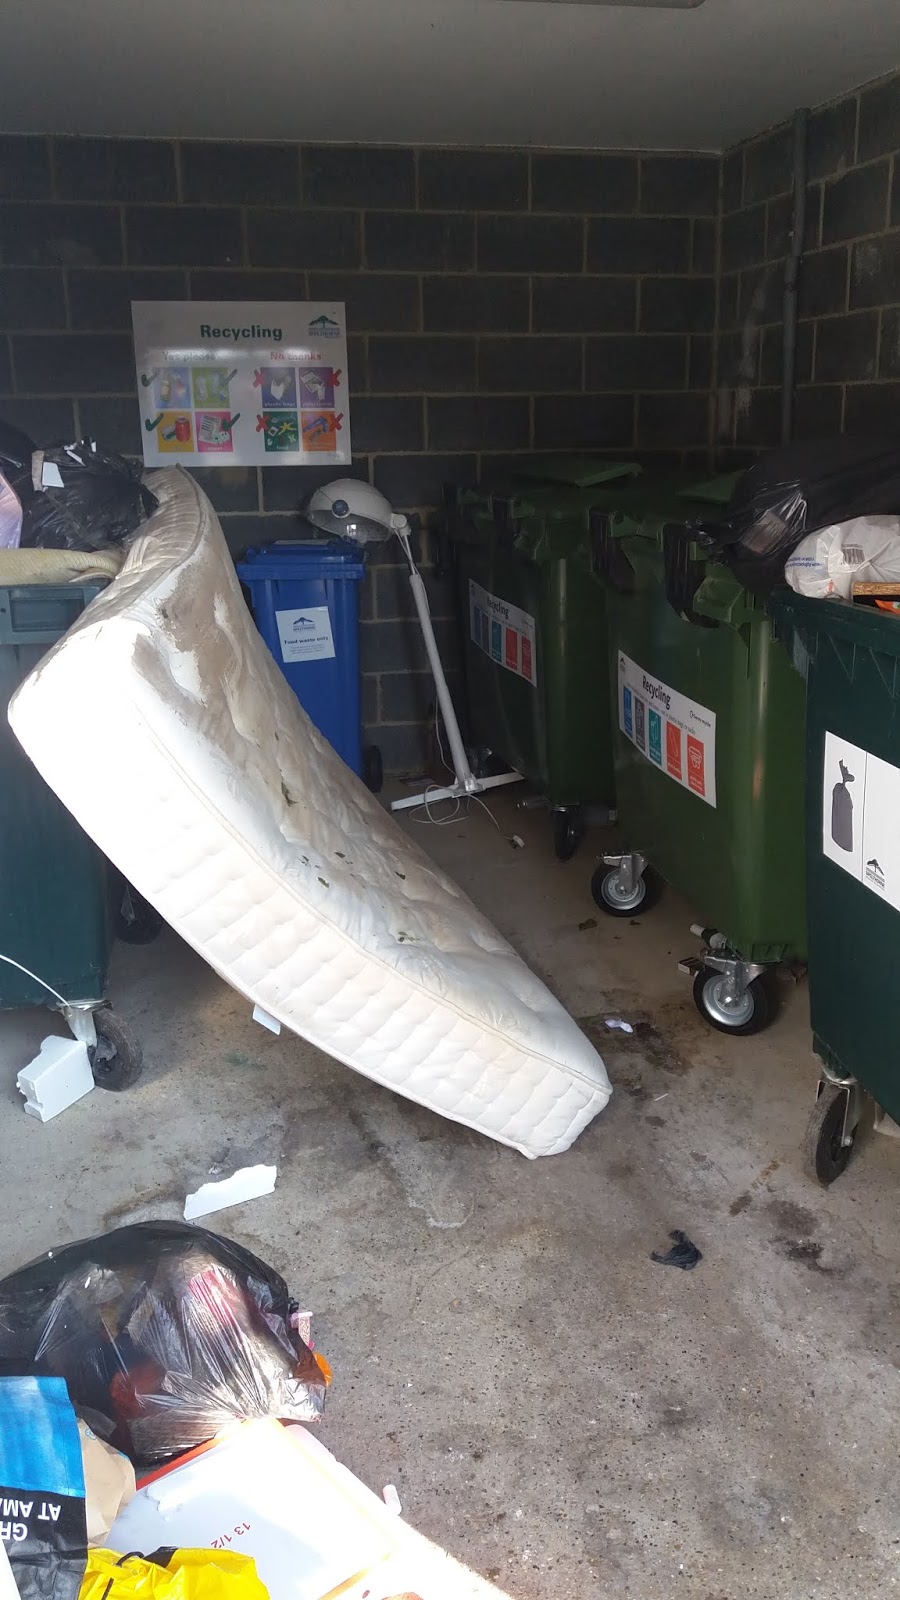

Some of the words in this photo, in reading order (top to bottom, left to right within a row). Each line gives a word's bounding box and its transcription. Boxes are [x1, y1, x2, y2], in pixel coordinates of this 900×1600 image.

[200, 325, 282, 341] Recycling
[270, 351, 285, 361] No
[487, 596, 510, 620] Recycling
[643, 675, 670, 710] Recycling
[37, 1502, 61, 1521] AT
[233, 1523, 251, 1536] 13
[210, 1534, 232, 1548] 1/2
